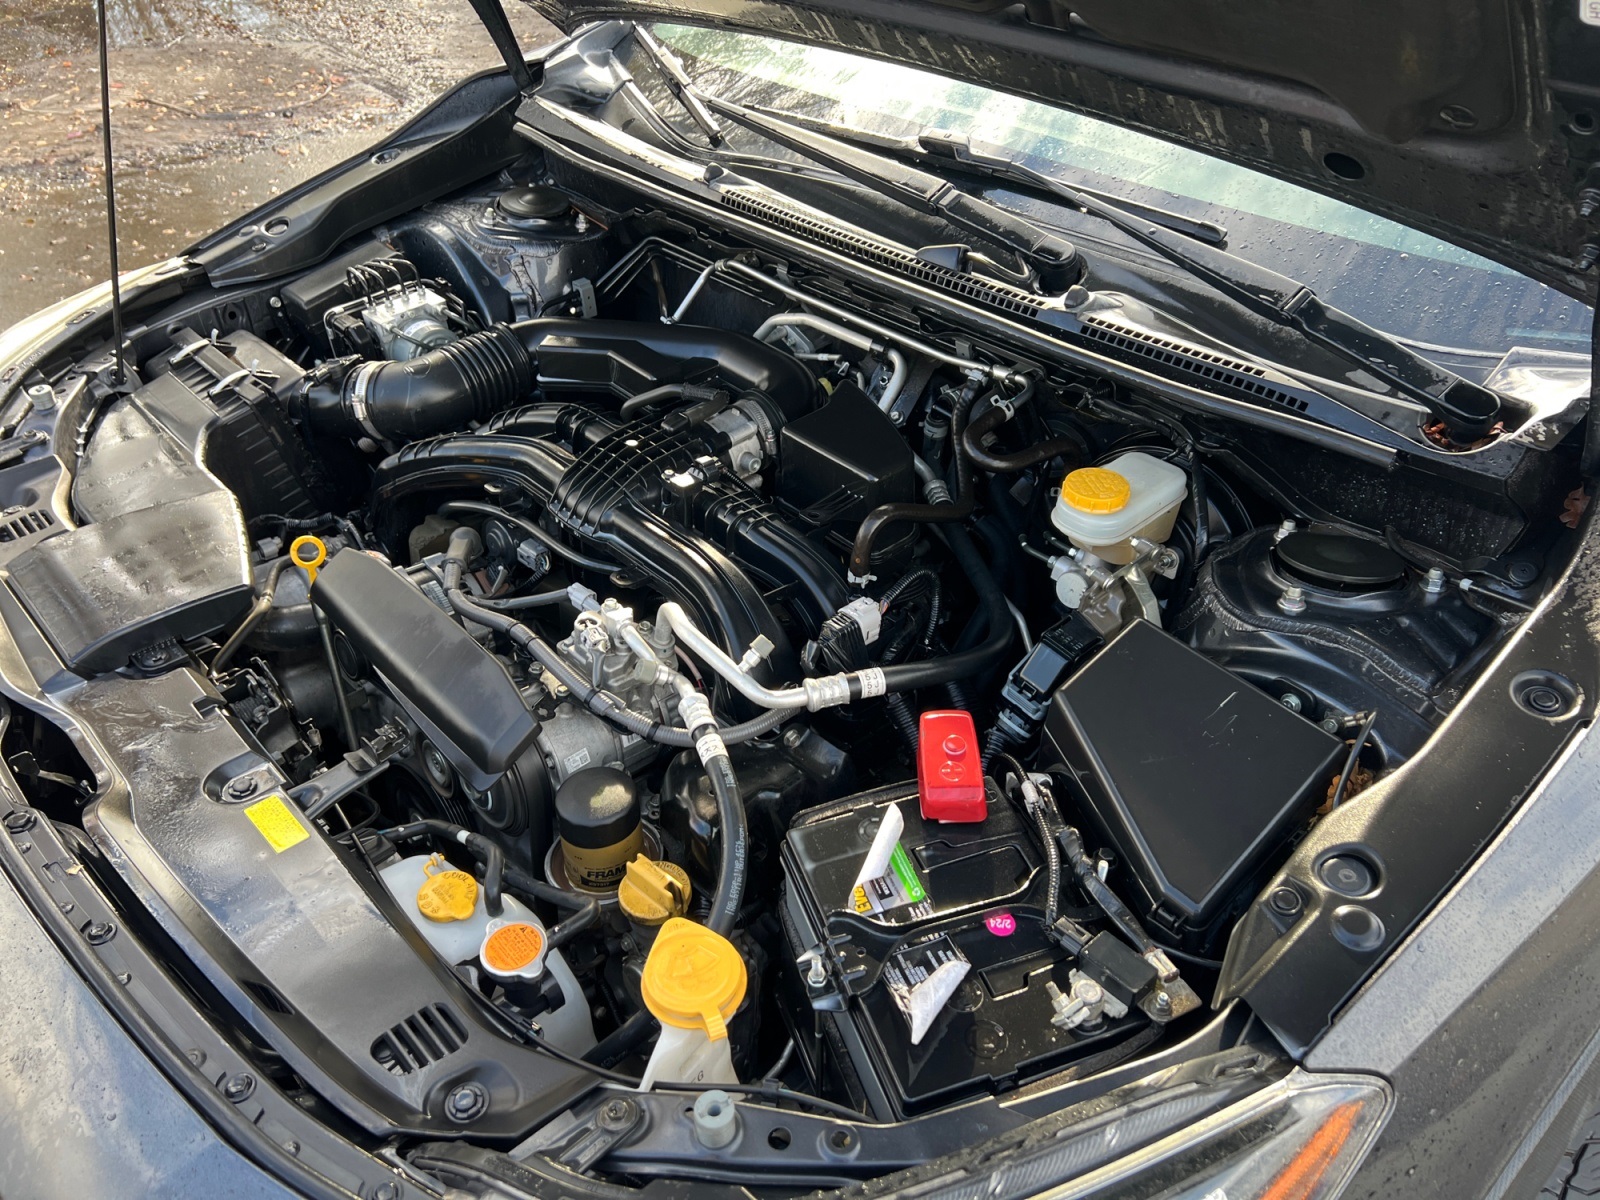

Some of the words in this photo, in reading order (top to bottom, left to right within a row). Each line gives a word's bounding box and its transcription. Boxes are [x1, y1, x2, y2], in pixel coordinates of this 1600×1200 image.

[586, 864, 627, 878] FRAM
[854, 885, 872, 912] Eve
[989, 917, 1012, 929] 2/24
